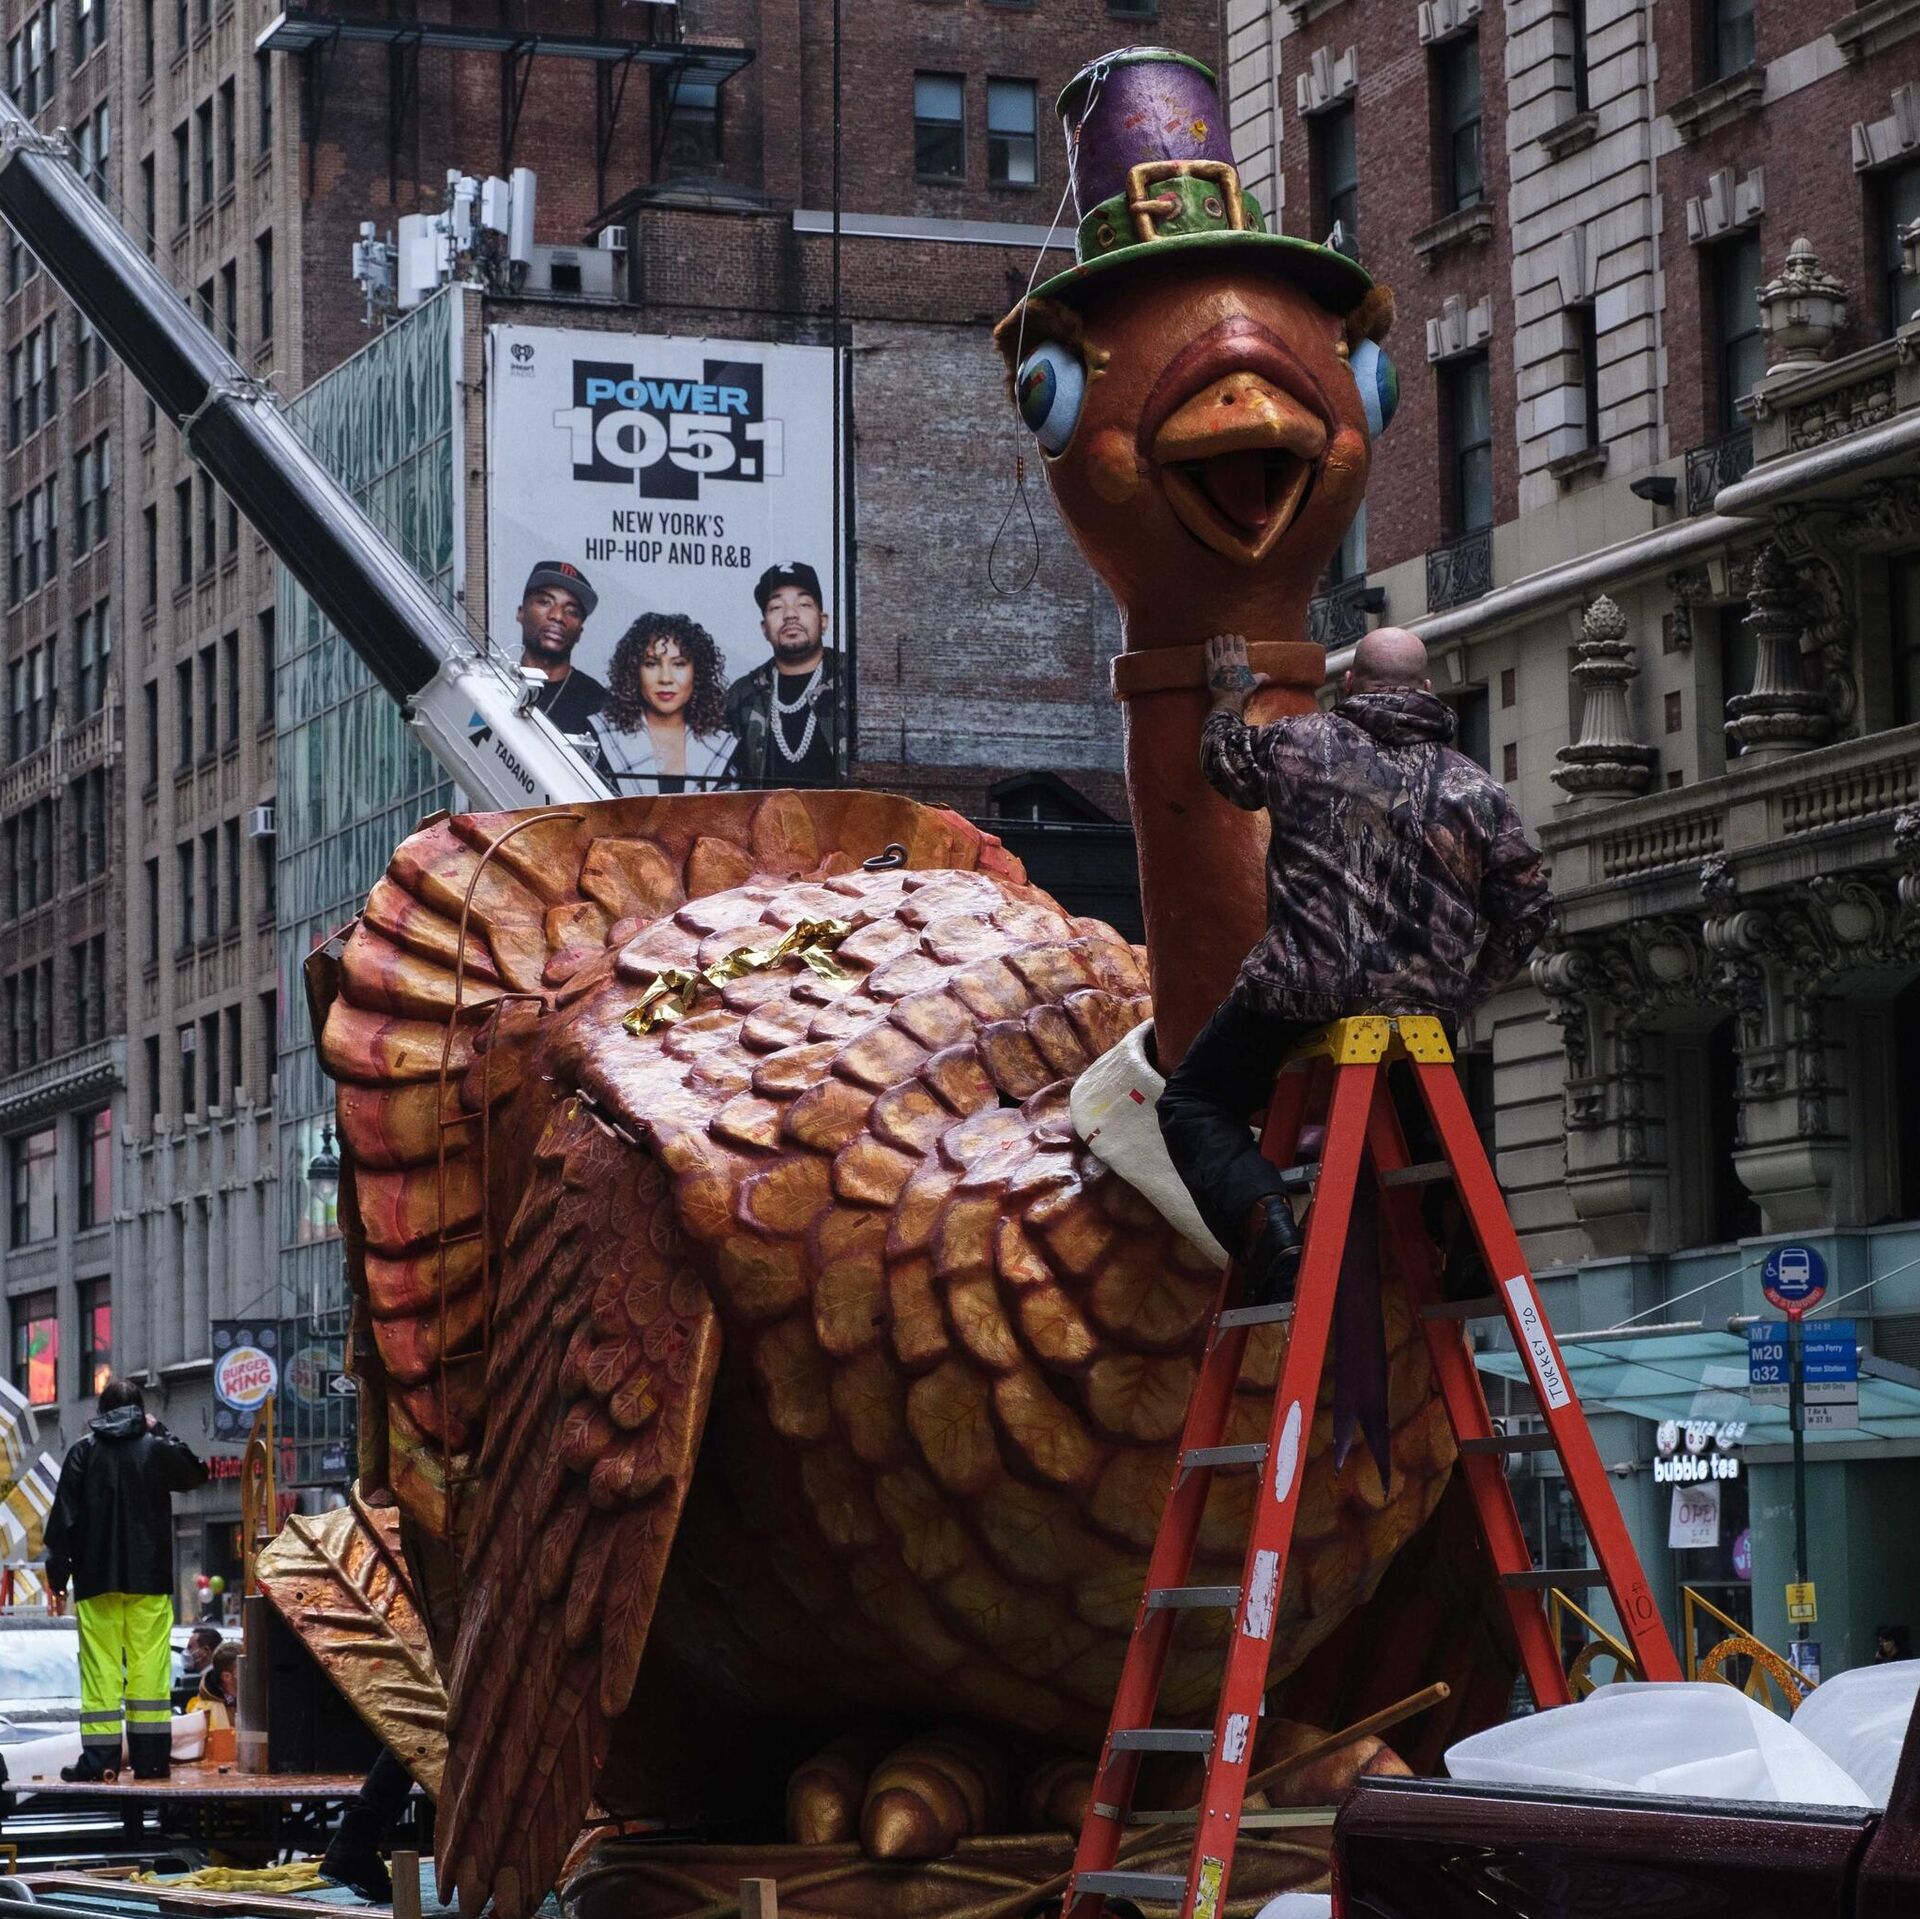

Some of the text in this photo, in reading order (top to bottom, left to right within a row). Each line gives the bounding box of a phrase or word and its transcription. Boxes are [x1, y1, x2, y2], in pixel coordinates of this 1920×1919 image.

[586, 377, 750, 416] POWER
[553, 406, 785, 478] 105.1
[612, 509, 725, 538] NEW YORK'S
[586, 537, 752, 569] HIP-HOP AND R&B
[495, 739, 536, 795] TADANO
[1751, 1325, 1773, 1341] M7
[1751, 1344, 1784, 1361] M20
[1805, 1343, 1843, 1353] South Ferry
[222, 1357, 270, 1382] BURGER
[224, 1368, 271, 1397] KING
[1531, 1340, 1563, 1401] TURKEY
[1751, 1365, 1780, 1381] Q32
[1805, 1364, 1847, 1373] Penn Station
[1653, 1452, 1739, 1482] bubble tea
